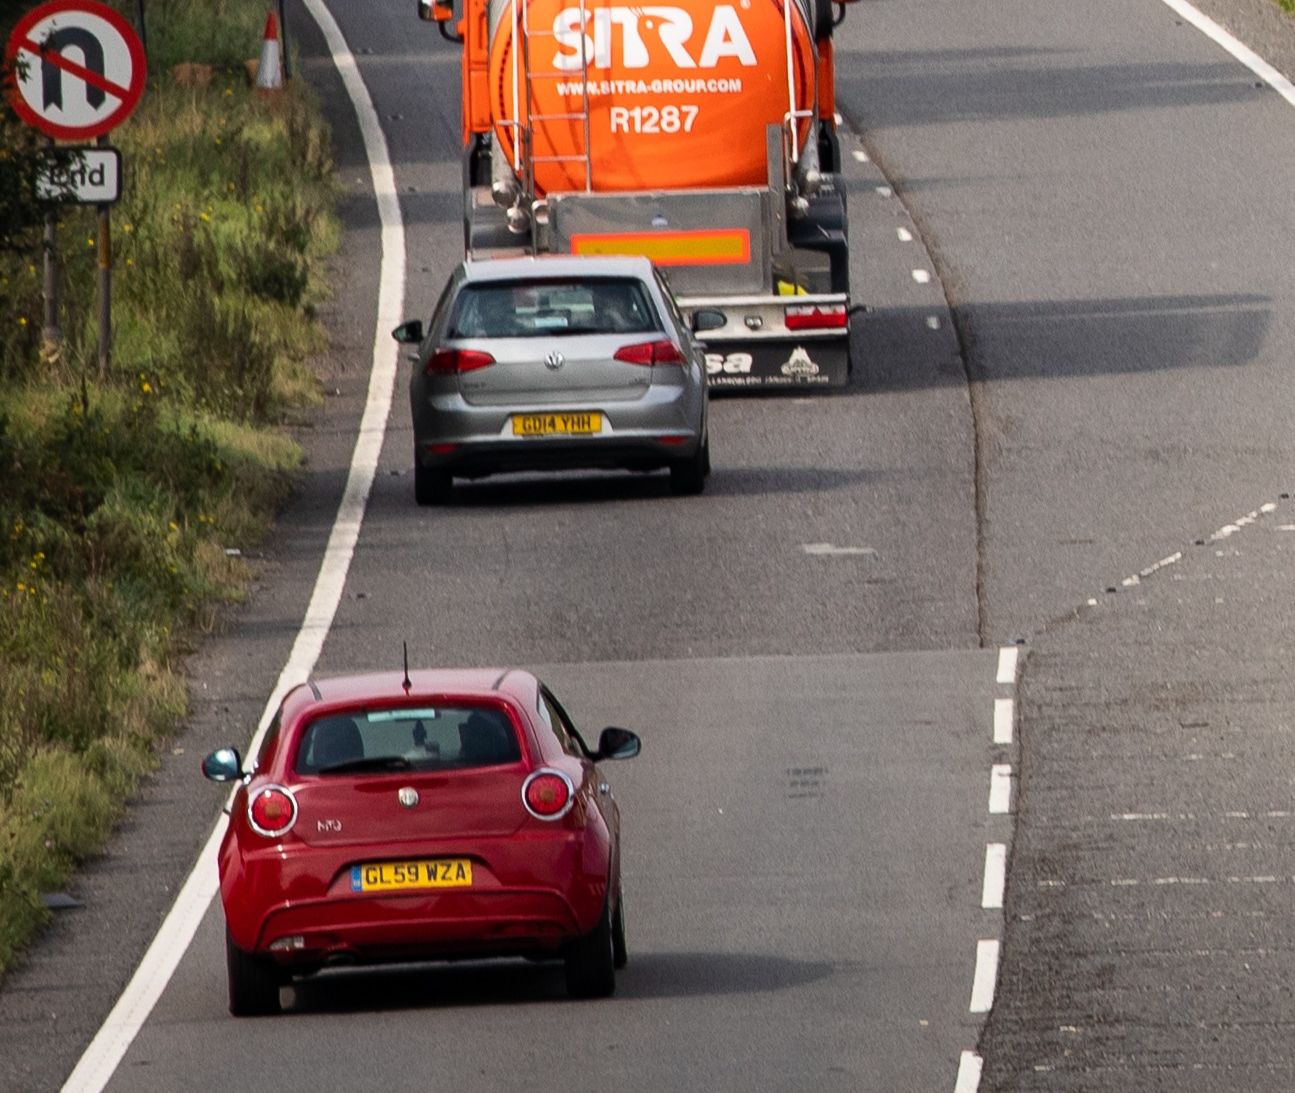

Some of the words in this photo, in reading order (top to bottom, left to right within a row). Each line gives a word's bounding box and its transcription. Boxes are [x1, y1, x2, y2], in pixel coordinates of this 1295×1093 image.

[553, 5, 757, 71] SITRA
[611, 106, 699, 134] R1287
[365, 863, 419, 885] GL59
[425, 861, 467, 882] WZA
